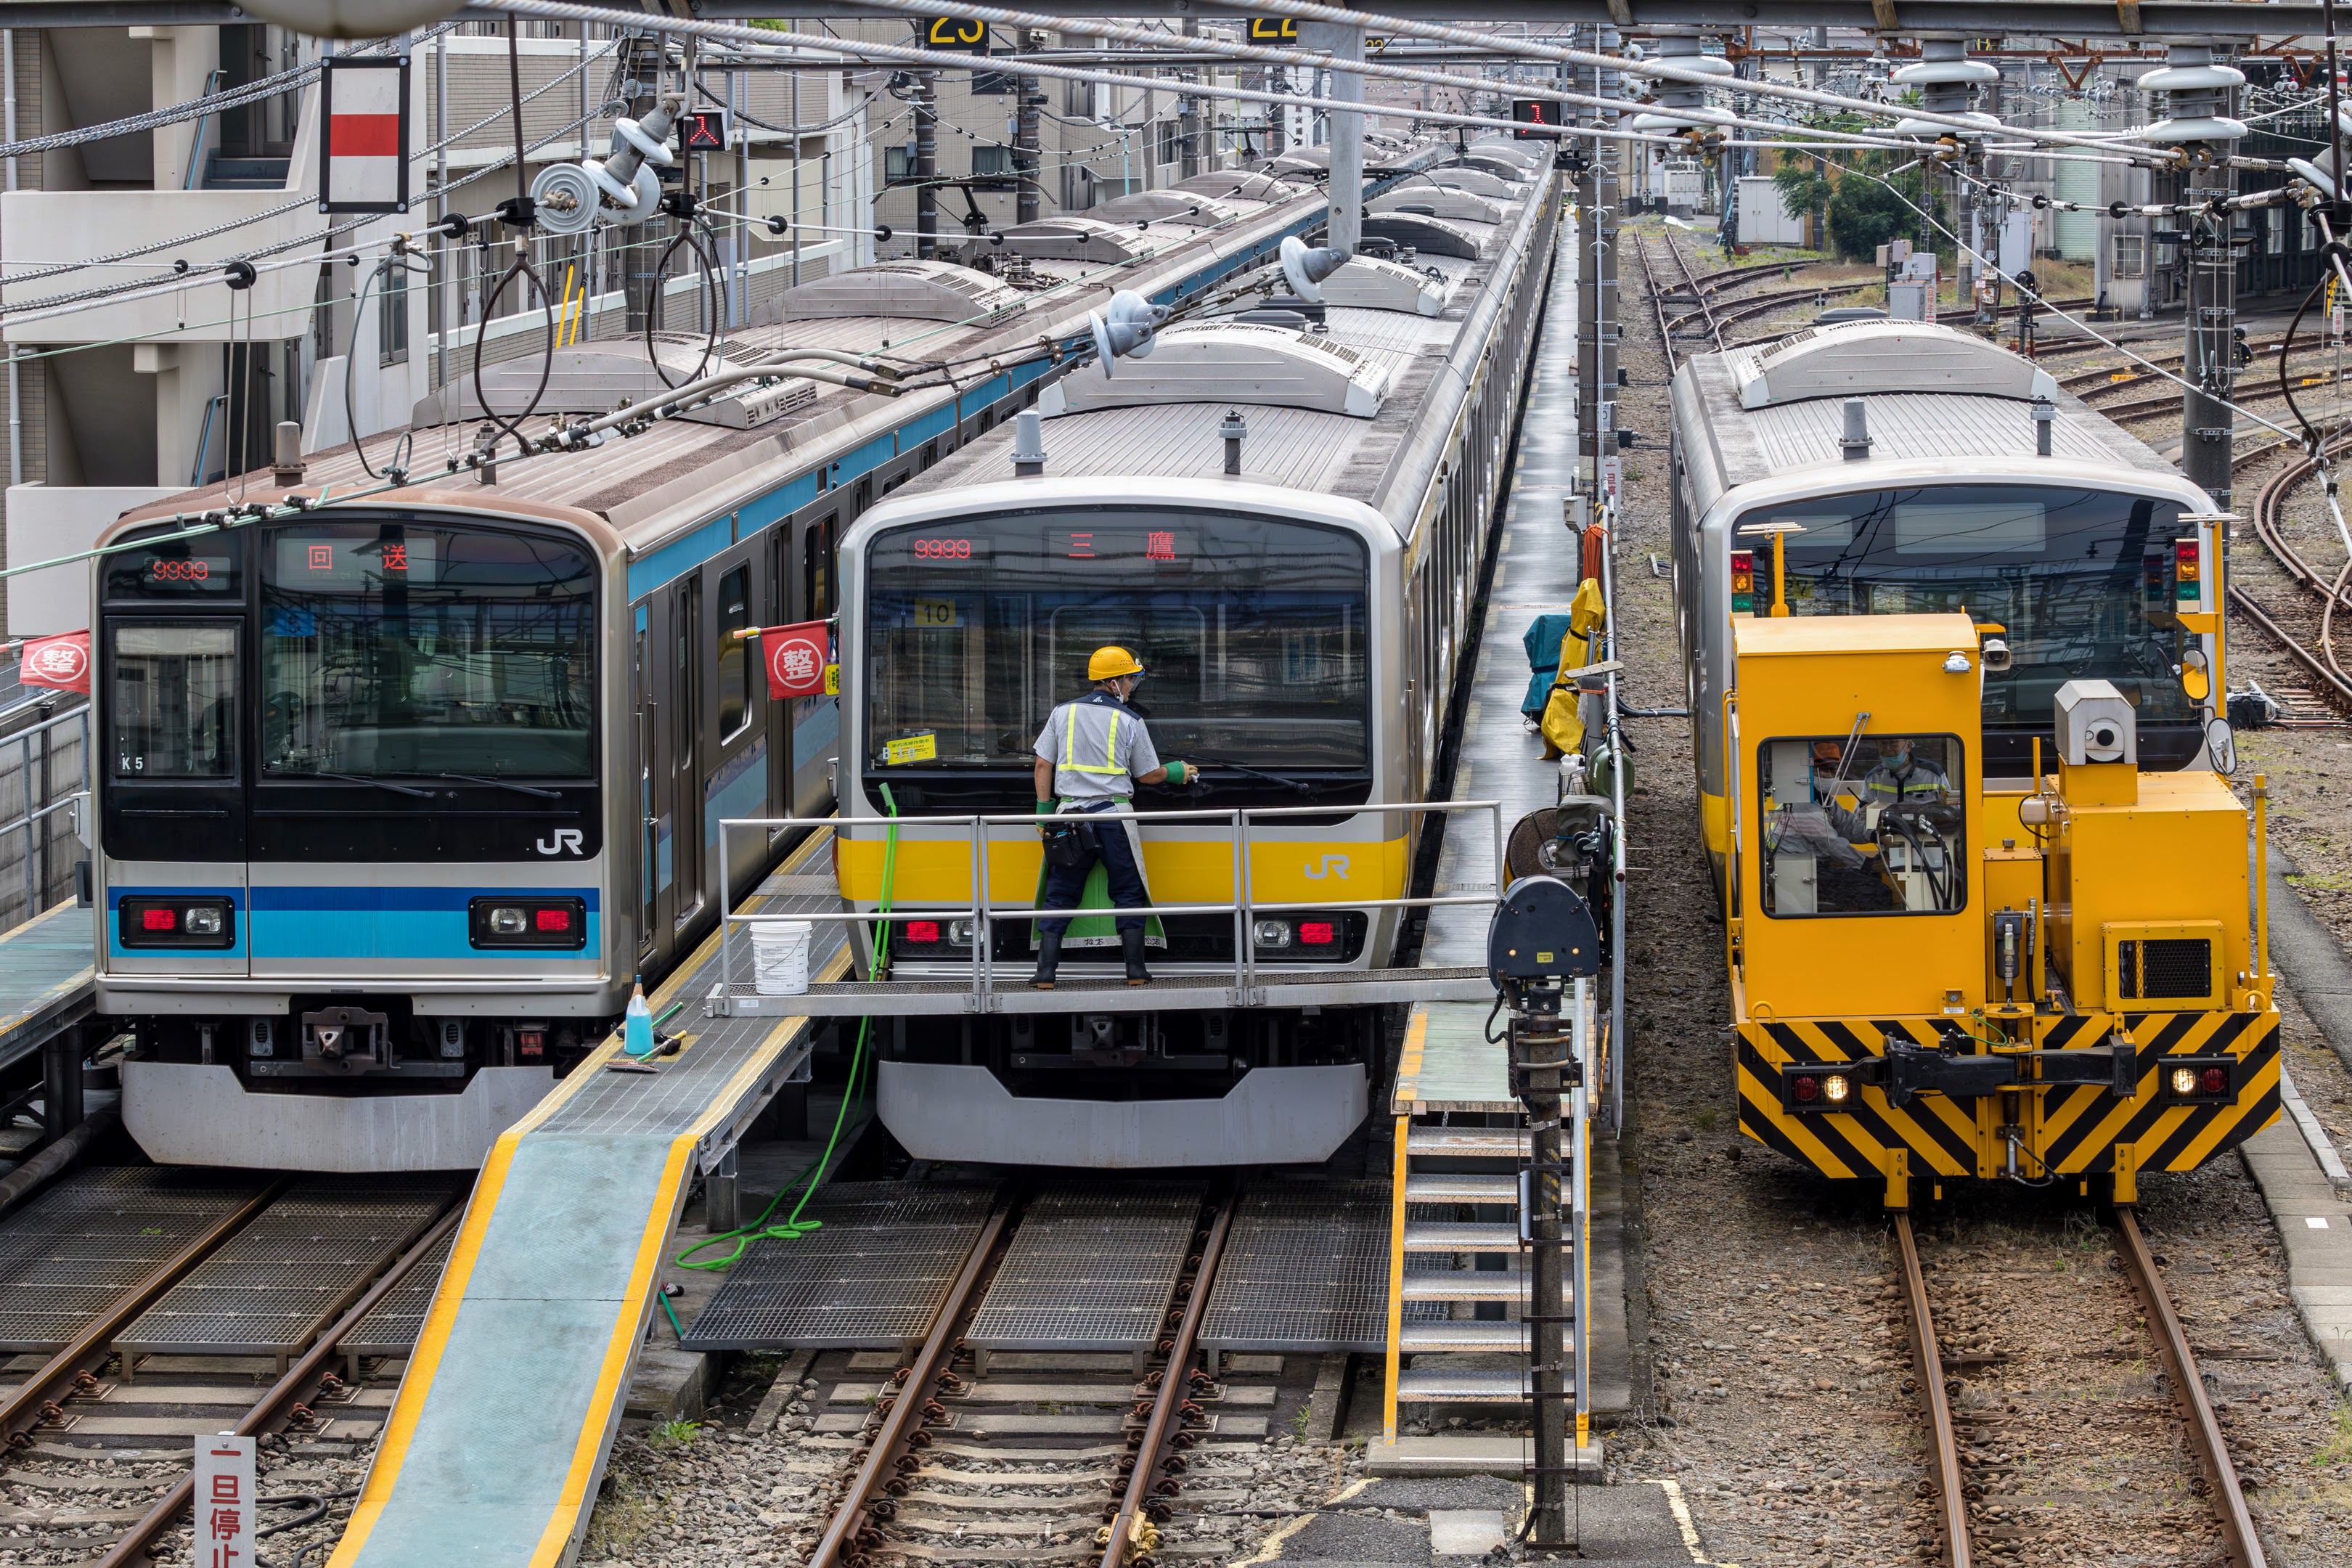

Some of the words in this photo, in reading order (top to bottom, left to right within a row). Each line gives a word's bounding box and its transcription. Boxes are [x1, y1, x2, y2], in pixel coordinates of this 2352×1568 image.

[914, 539, 971, 559] 9999
[152, 561, 208, 581] 9999
[924, 604, 949, 623] 10
[42, 649, 75, 673] 整
[783, 648, 814, 680] 整
[537, 829, 584, 854] JR
[1304, 854, 1349, 879] JR
[210, 1449, 242, 1568] 一旦停止
